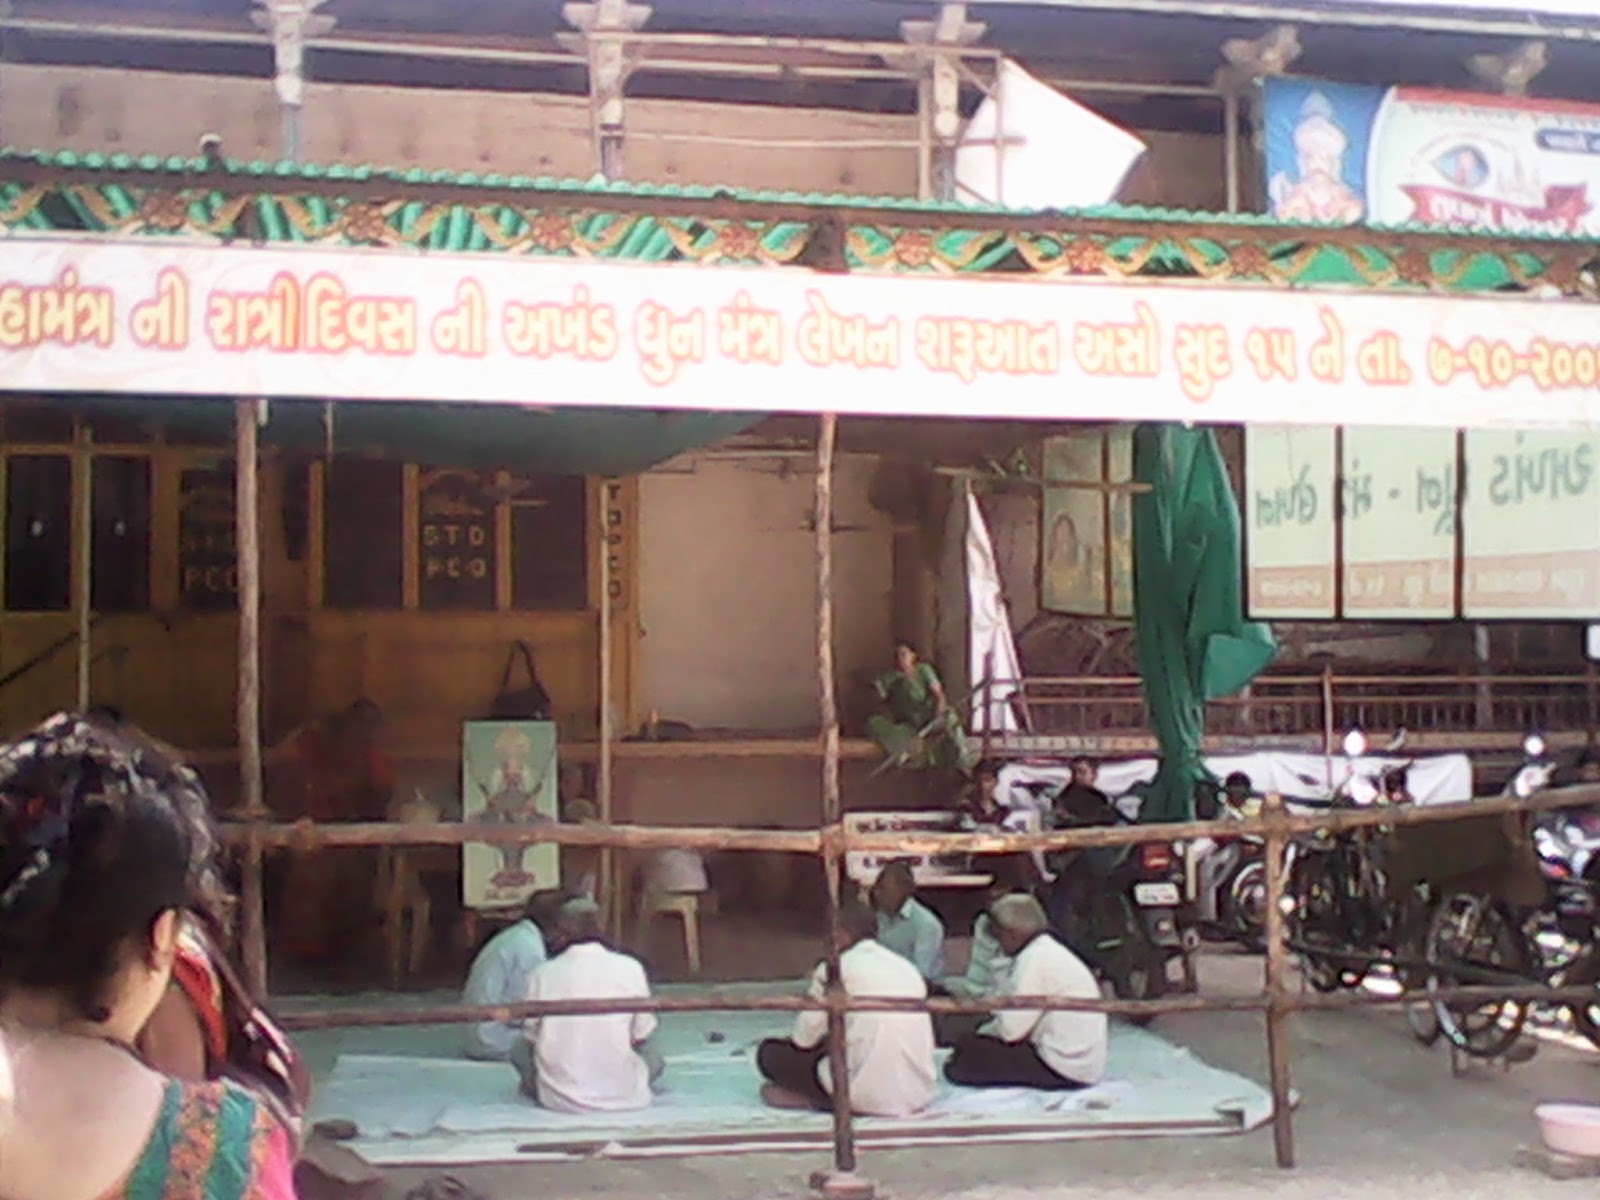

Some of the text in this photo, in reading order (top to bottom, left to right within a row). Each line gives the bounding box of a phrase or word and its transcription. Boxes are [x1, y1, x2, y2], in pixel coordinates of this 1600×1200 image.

[132, 266, 190, 349] ની
[432, 277, 487, 357] ની
[503, 283, 618, 361] અખંડ
[717, 290, 784, 364] મંત્ર
[798, 289, 899, 369] લેખન
[1174, 323, 1233, 402] સુદ
[1246, 326, 1297, 382] ૧૫
[1308, 305, 1344, 383] ને
[1427, 335, 1600, 391] ૭-૧૦-૨૦૦
[423, 523, 486, 547] STD
[426, 556, 487, 580] PCO
